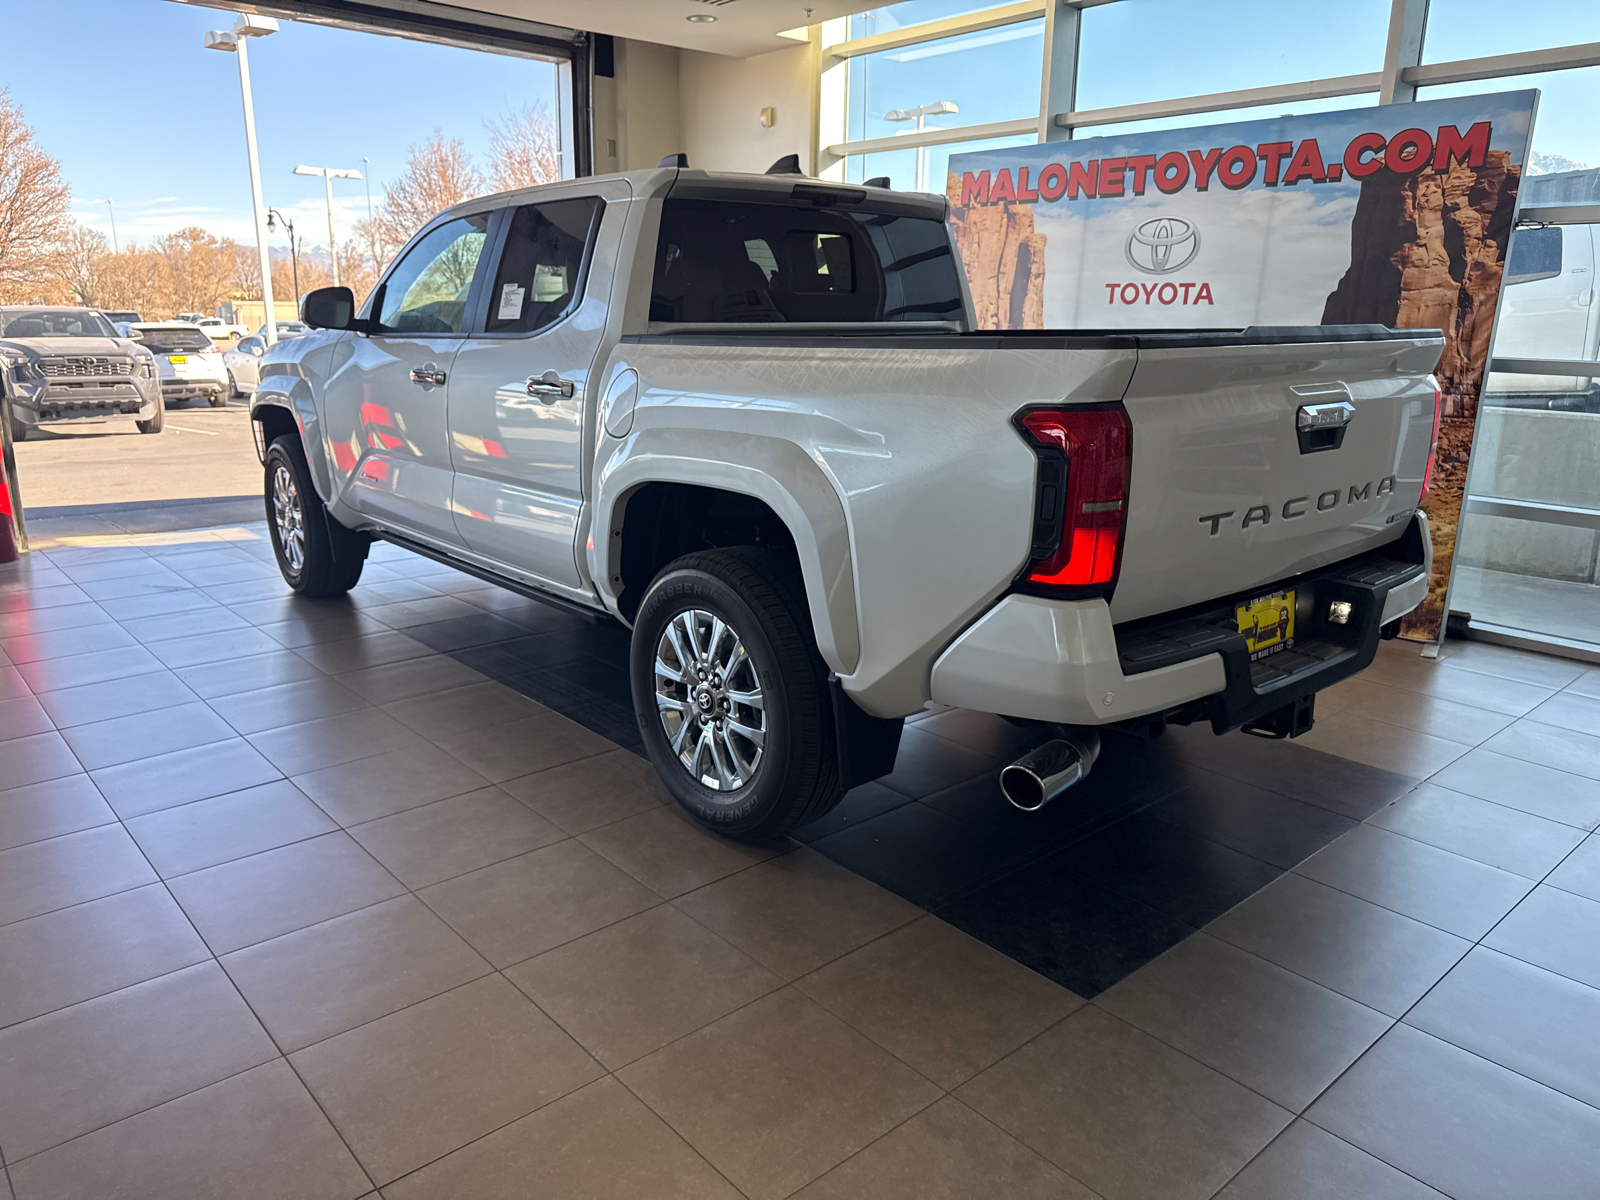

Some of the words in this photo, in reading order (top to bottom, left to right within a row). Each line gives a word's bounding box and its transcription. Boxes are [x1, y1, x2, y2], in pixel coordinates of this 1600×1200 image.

[961, 121, 1492, 208] MALONETOYOTA.COM
[1105, 282, 1214, 305] TOYOTA
[1199, 475, 1396, 535] TACOMA
[647, 583, 702, 616] GRABBER
[697, 794, 759, 822] GENERAL
